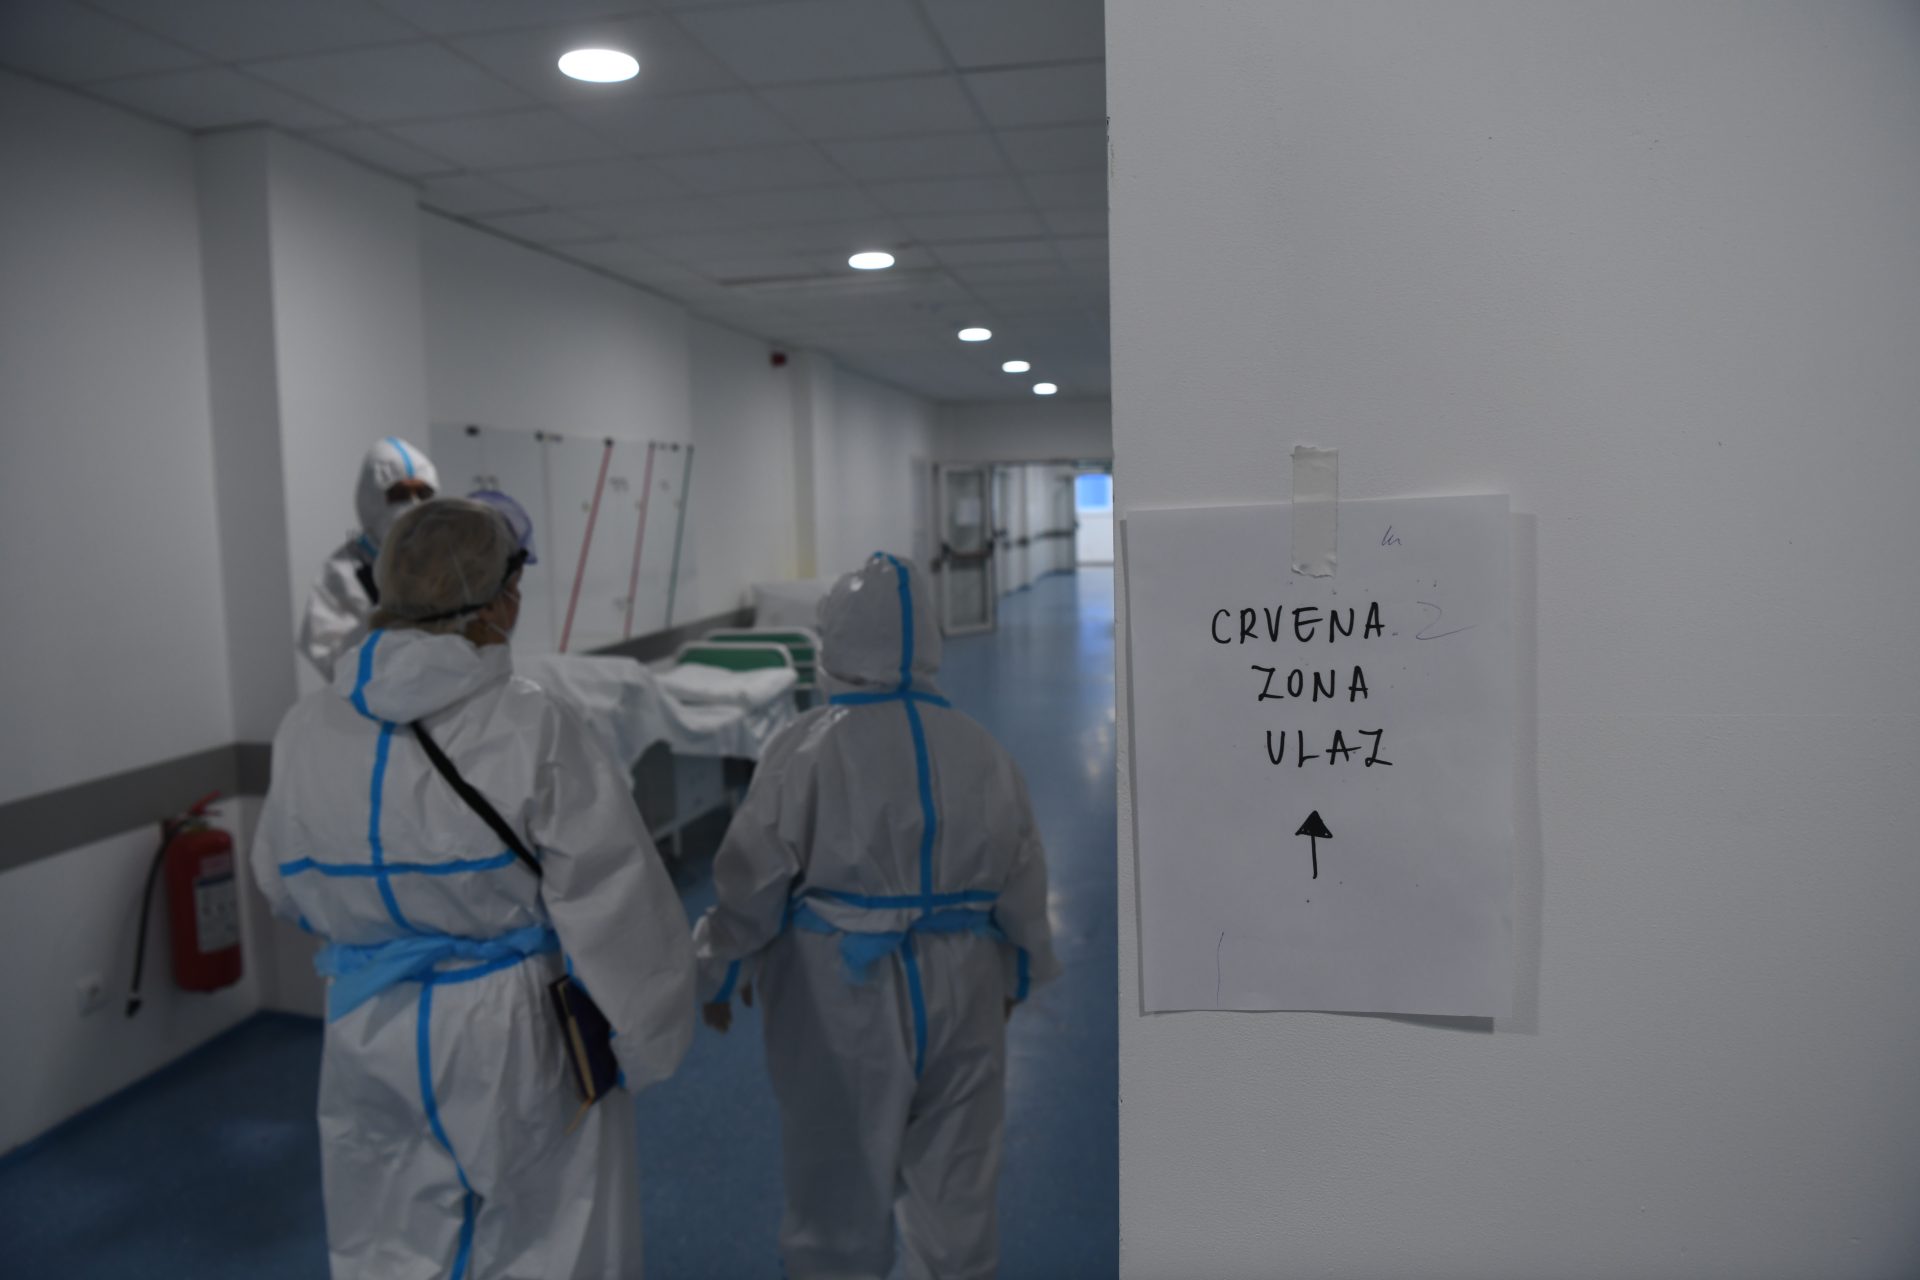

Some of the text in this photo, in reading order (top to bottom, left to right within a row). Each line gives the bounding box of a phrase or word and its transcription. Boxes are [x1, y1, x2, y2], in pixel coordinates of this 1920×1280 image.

[1211, 601, 1386, 645] CRVENA
[1250, 664, 1369, 703] ZONA
[1266, 728, 1393, 769] ULAZ
